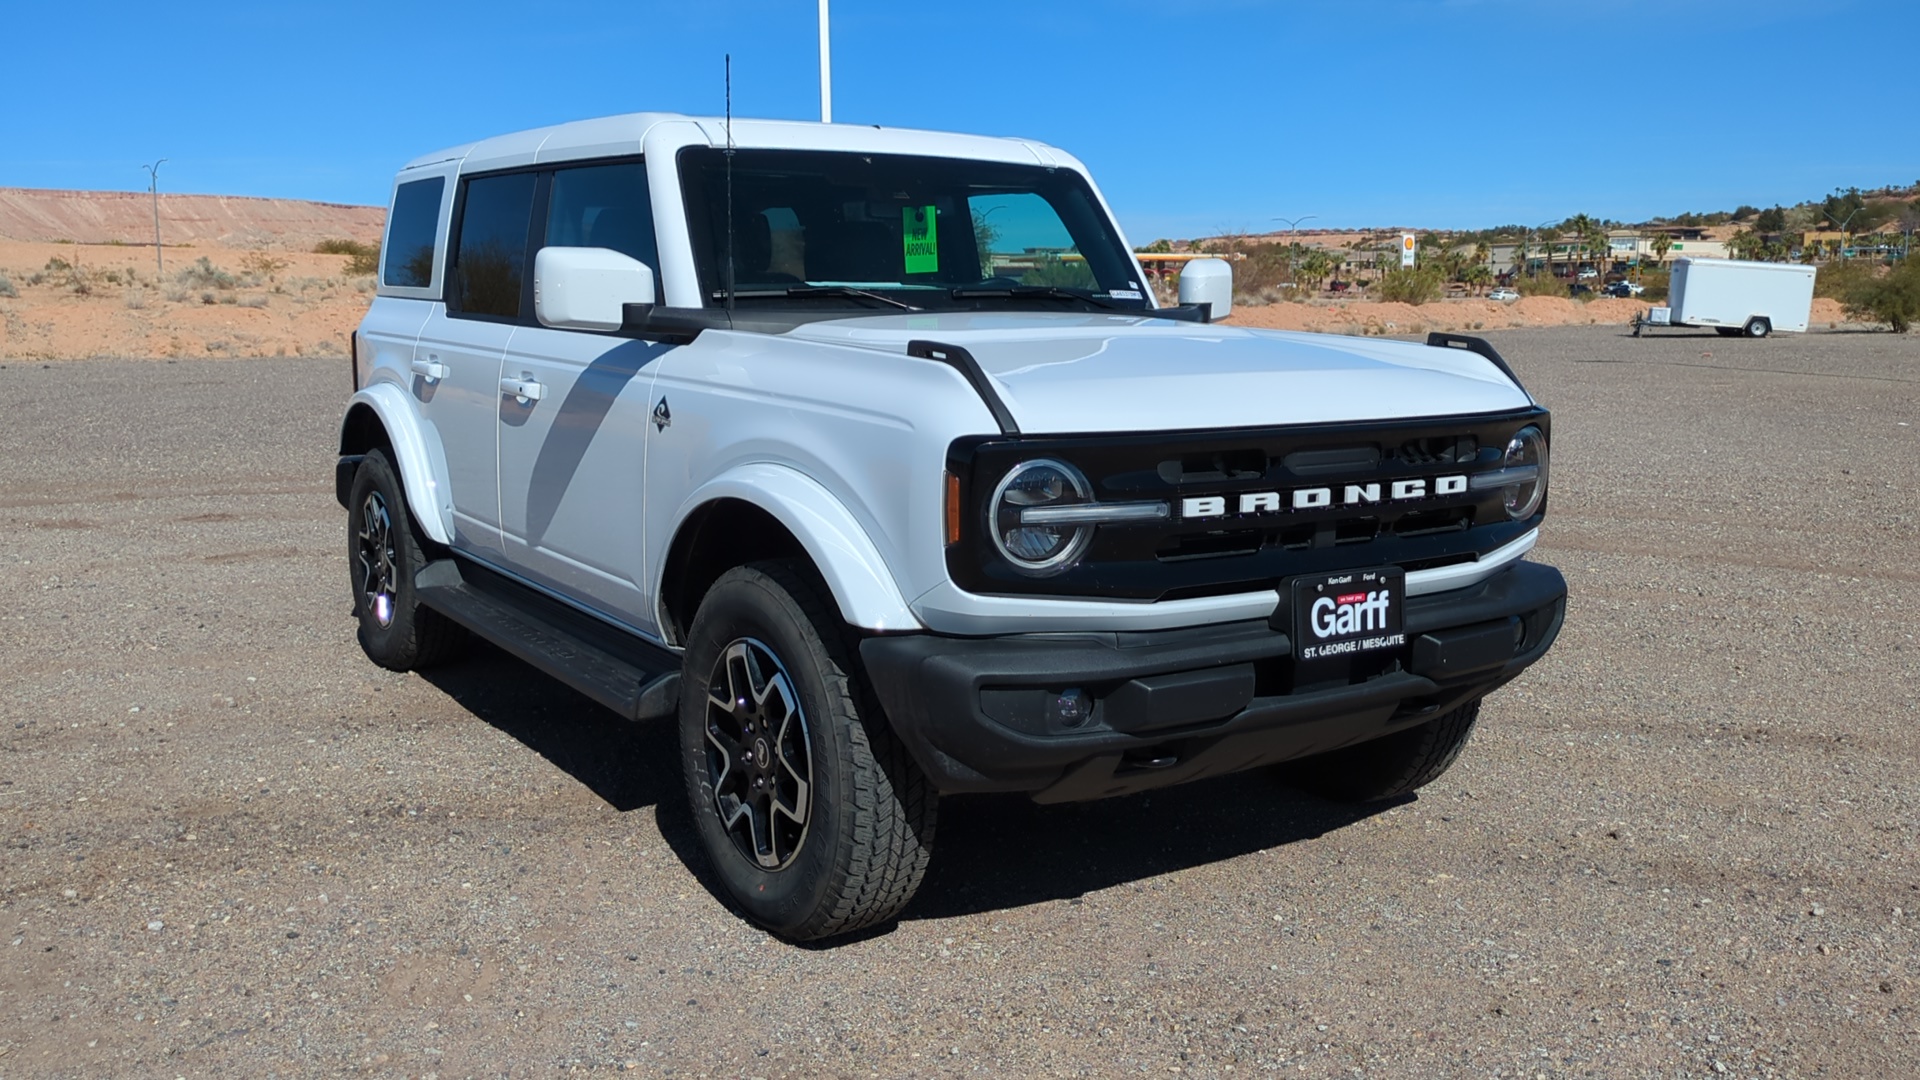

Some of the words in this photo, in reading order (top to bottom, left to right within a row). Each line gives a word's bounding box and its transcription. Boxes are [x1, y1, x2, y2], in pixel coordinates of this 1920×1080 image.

[911, 227, 927, 241] NEW
[906, 242, 936, 257] ARRIVAL!
[1182, 475, 1468, 518] BRONCO
[1328, 577, 1338, 585] Ken
[1339, 575, 1352, 584] Garff
[1363, 572, 1376, 581] Ford
[1311, 589, 1389, 638] Garff
[1304, 647, 1318, 659] ST.
[1319, 641, 1357, 656] GEORGE
[1362, 634, 1405, 649] MESQUITE
